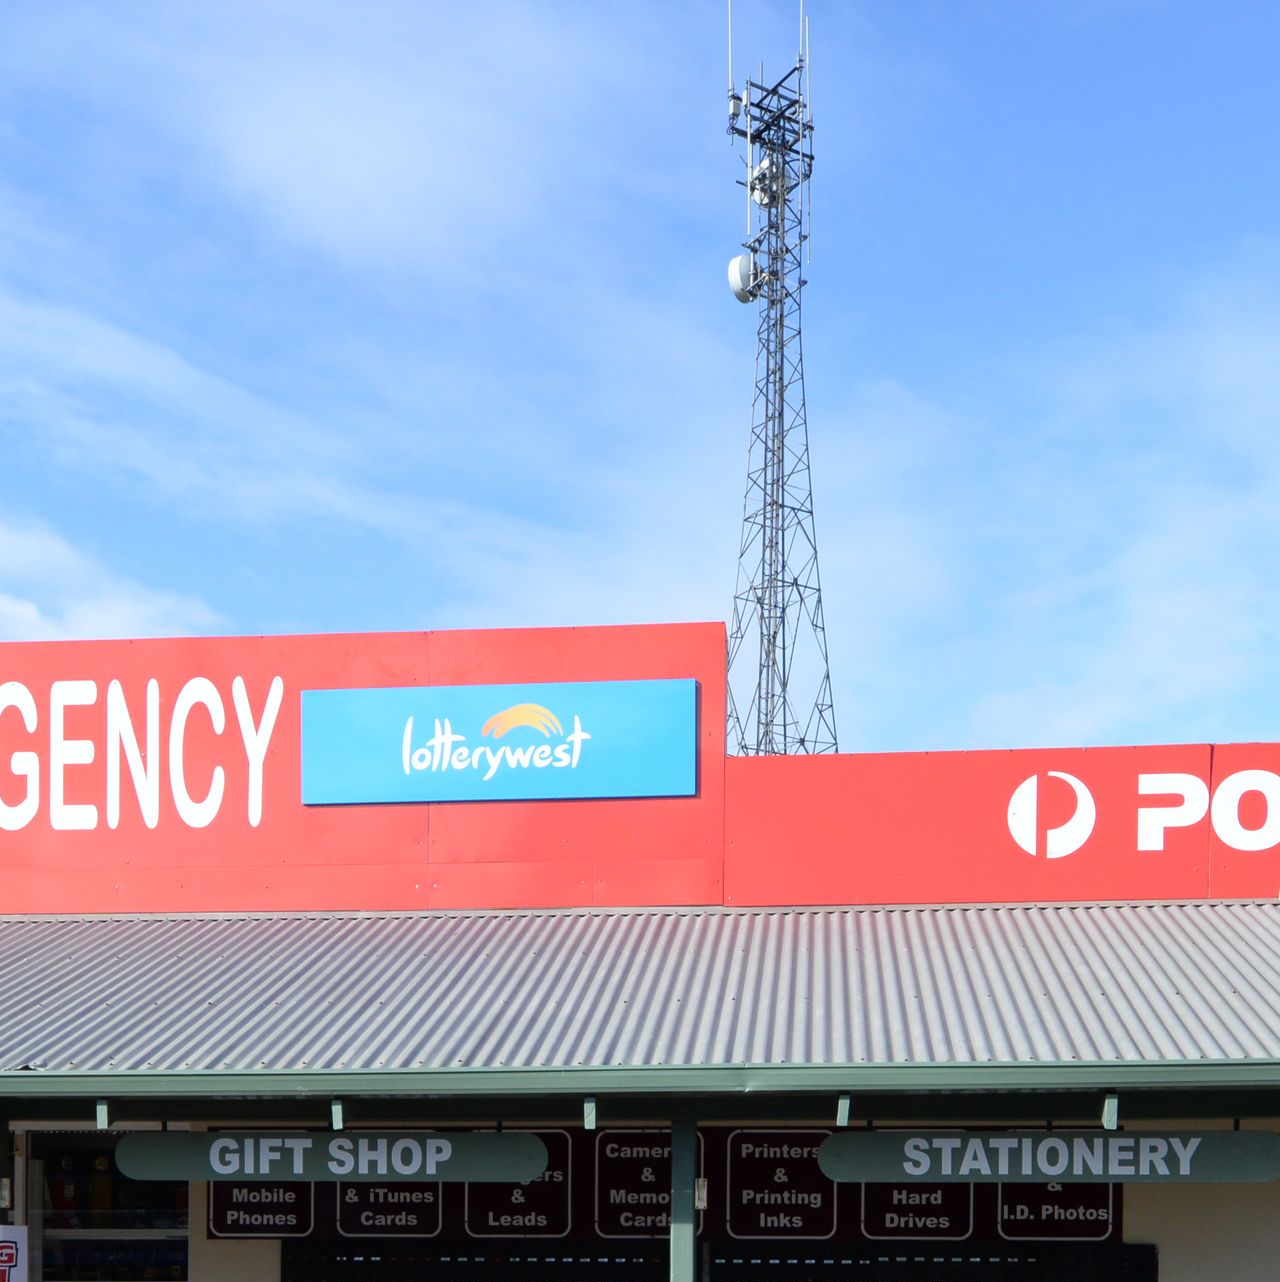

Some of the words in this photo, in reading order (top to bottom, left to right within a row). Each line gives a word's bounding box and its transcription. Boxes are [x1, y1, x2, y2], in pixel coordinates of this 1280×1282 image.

[401, 715, 593, 782] lotterywest
[209, 1137, 312, 1175] GIFT
[327, 1137, 452, 1175] SHOP
[605, 1143, 671, 1159] Camer
[902, 1137, 1202, 1176] STATIONERY
[641, 1167, 656, 1182] &
[773, 1168, 790, 1183] &
[232, 1188, 296, 1203] Mobile
[345, 1188, 359, 1203] &
[369, 1187, 434, 1203] iTunes
[510, 1188, 525, 1203] &
[609, 1189, 671, 1204] Memo
[741, 1189, 822, 1208] Printing
[892, 1190, 943, 1205] Hard
[226, 1210, 297, 1226] Phones
[360, 1211, 418, 1226] Cards
[488, 1211, 548, 1227] Leads
[1003, 1205, 1035, 1220] I.D.
[1042, 1205, 1108, 1220] Photos
[759, 1213, 803, 1228] Inks
[885, 1213, 950, 1229] Drives
